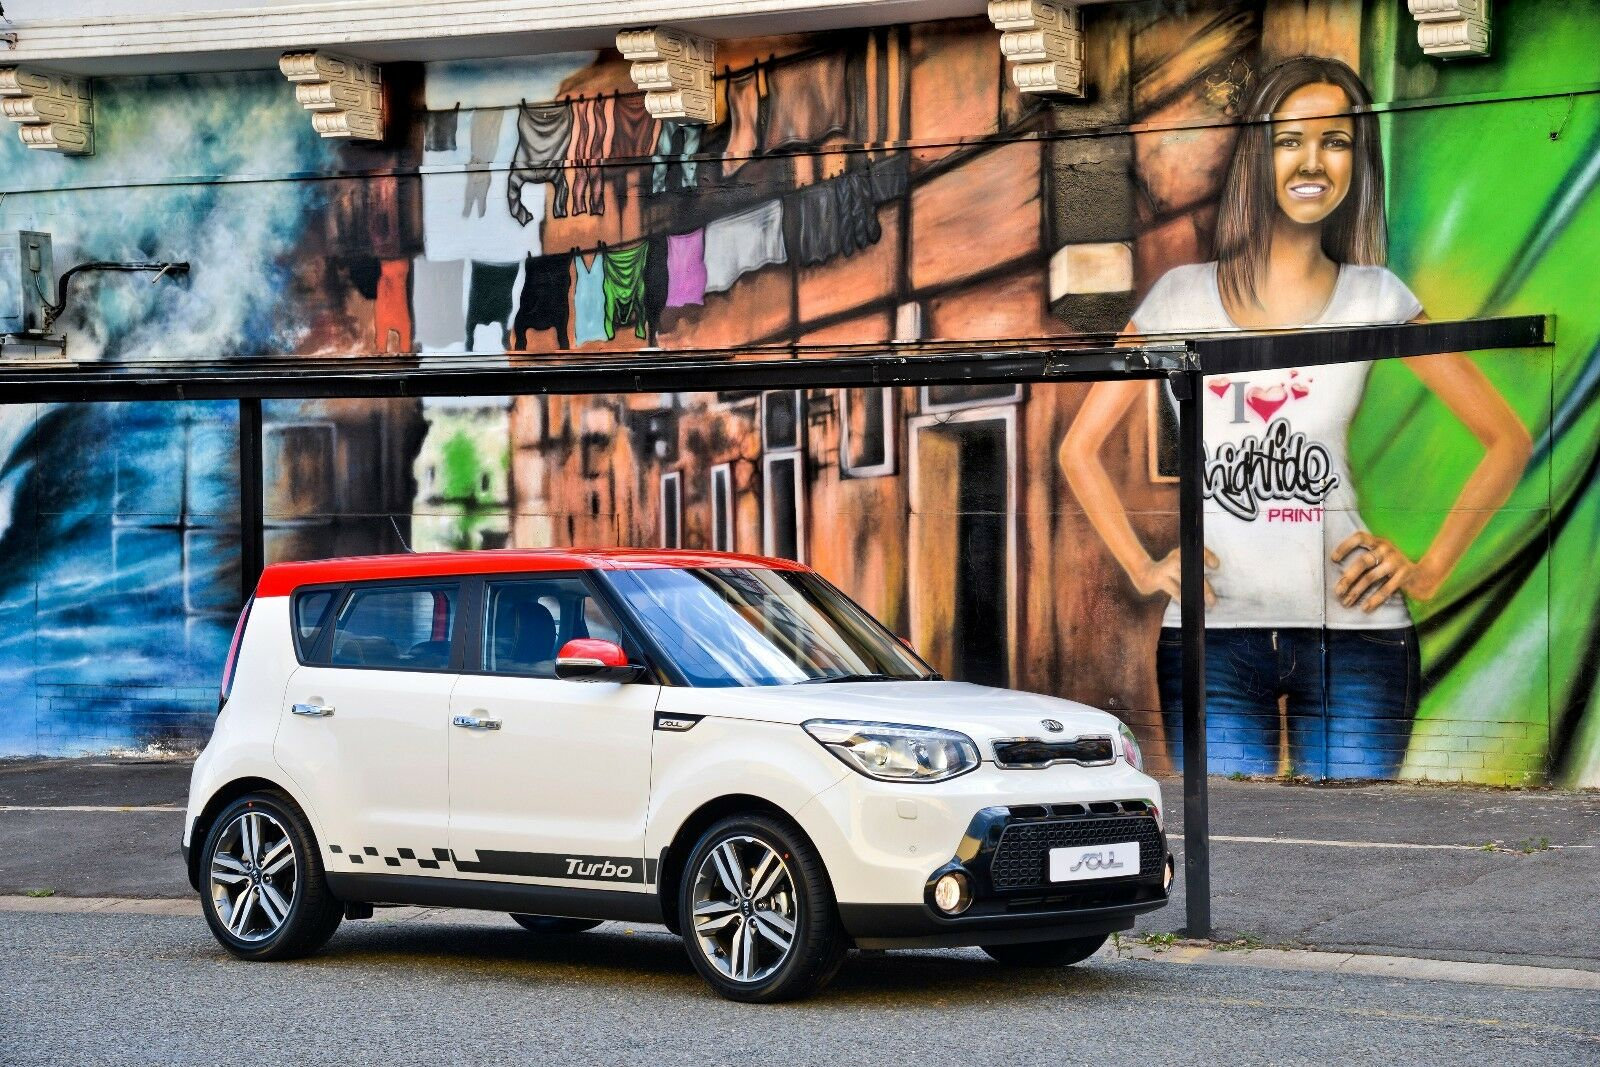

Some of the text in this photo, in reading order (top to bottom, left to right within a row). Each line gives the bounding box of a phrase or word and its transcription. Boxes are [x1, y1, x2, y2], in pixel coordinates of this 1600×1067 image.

[1229, 381, 1250, 424] I
[1268, 508, 1323, 522] PRINT
[565, 858, 633, 878] Turbo
[1070, 851, 1123, 871] SOUL
